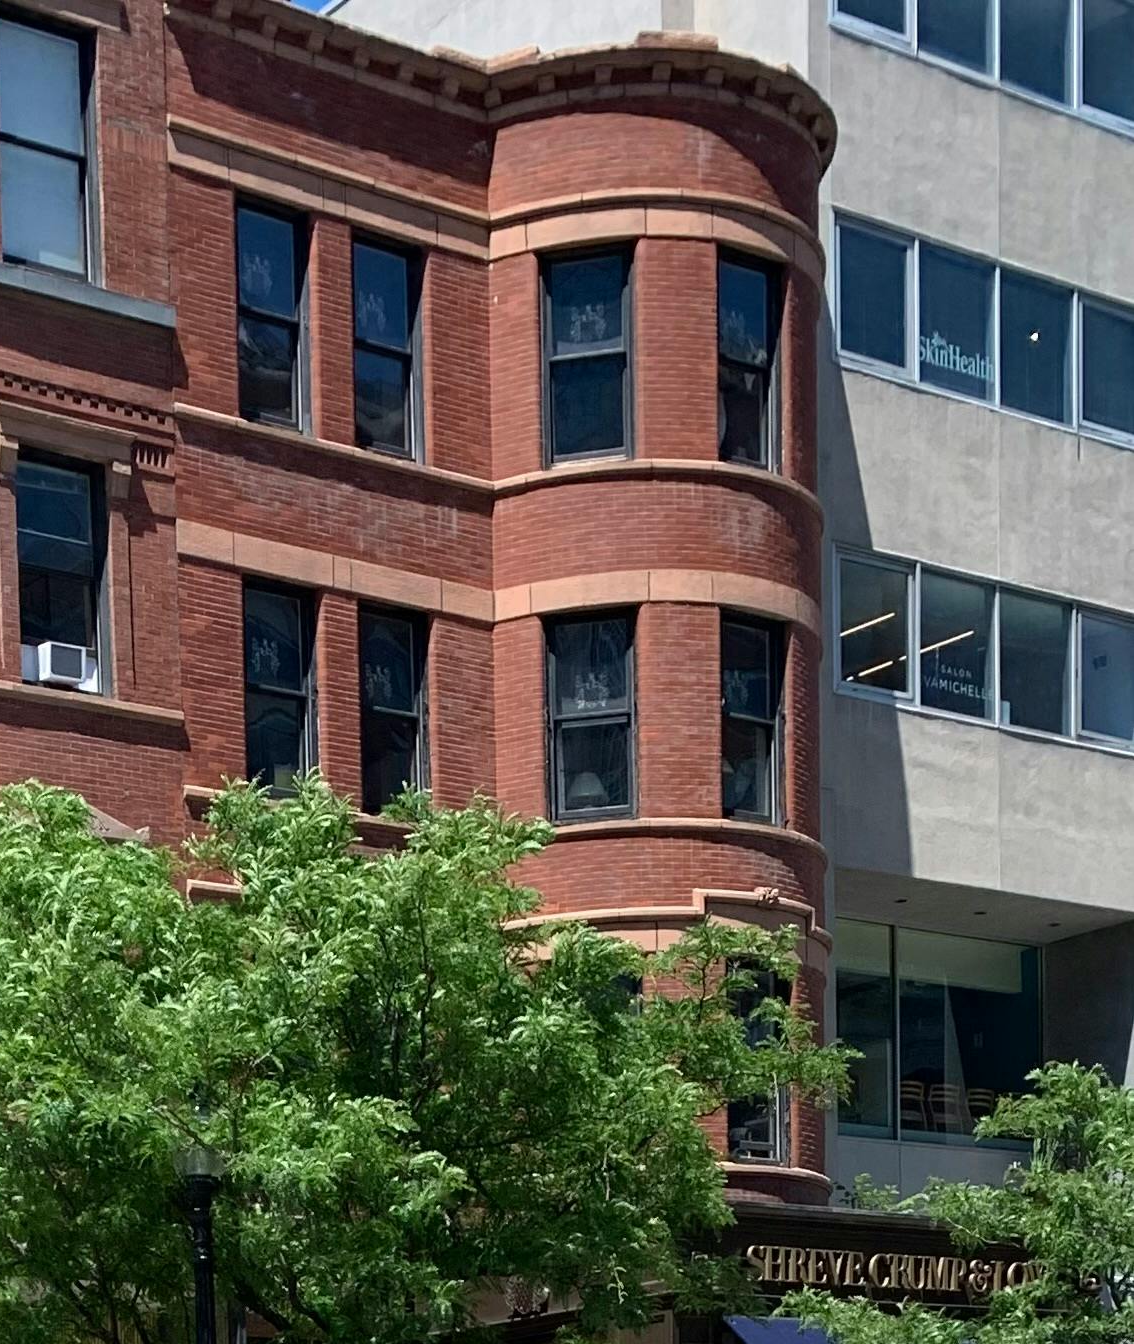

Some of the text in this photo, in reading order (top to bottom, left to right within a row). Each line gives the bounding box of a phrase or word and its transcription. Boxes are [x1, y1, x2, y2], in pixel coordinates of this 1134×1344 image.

[941, 664, 972, 678] SALON
[746, 1245, 866, 1286] SHREVE
[868, 1253, 966, 1292] CRUMP
[968, 1259, 993, 1292] &
